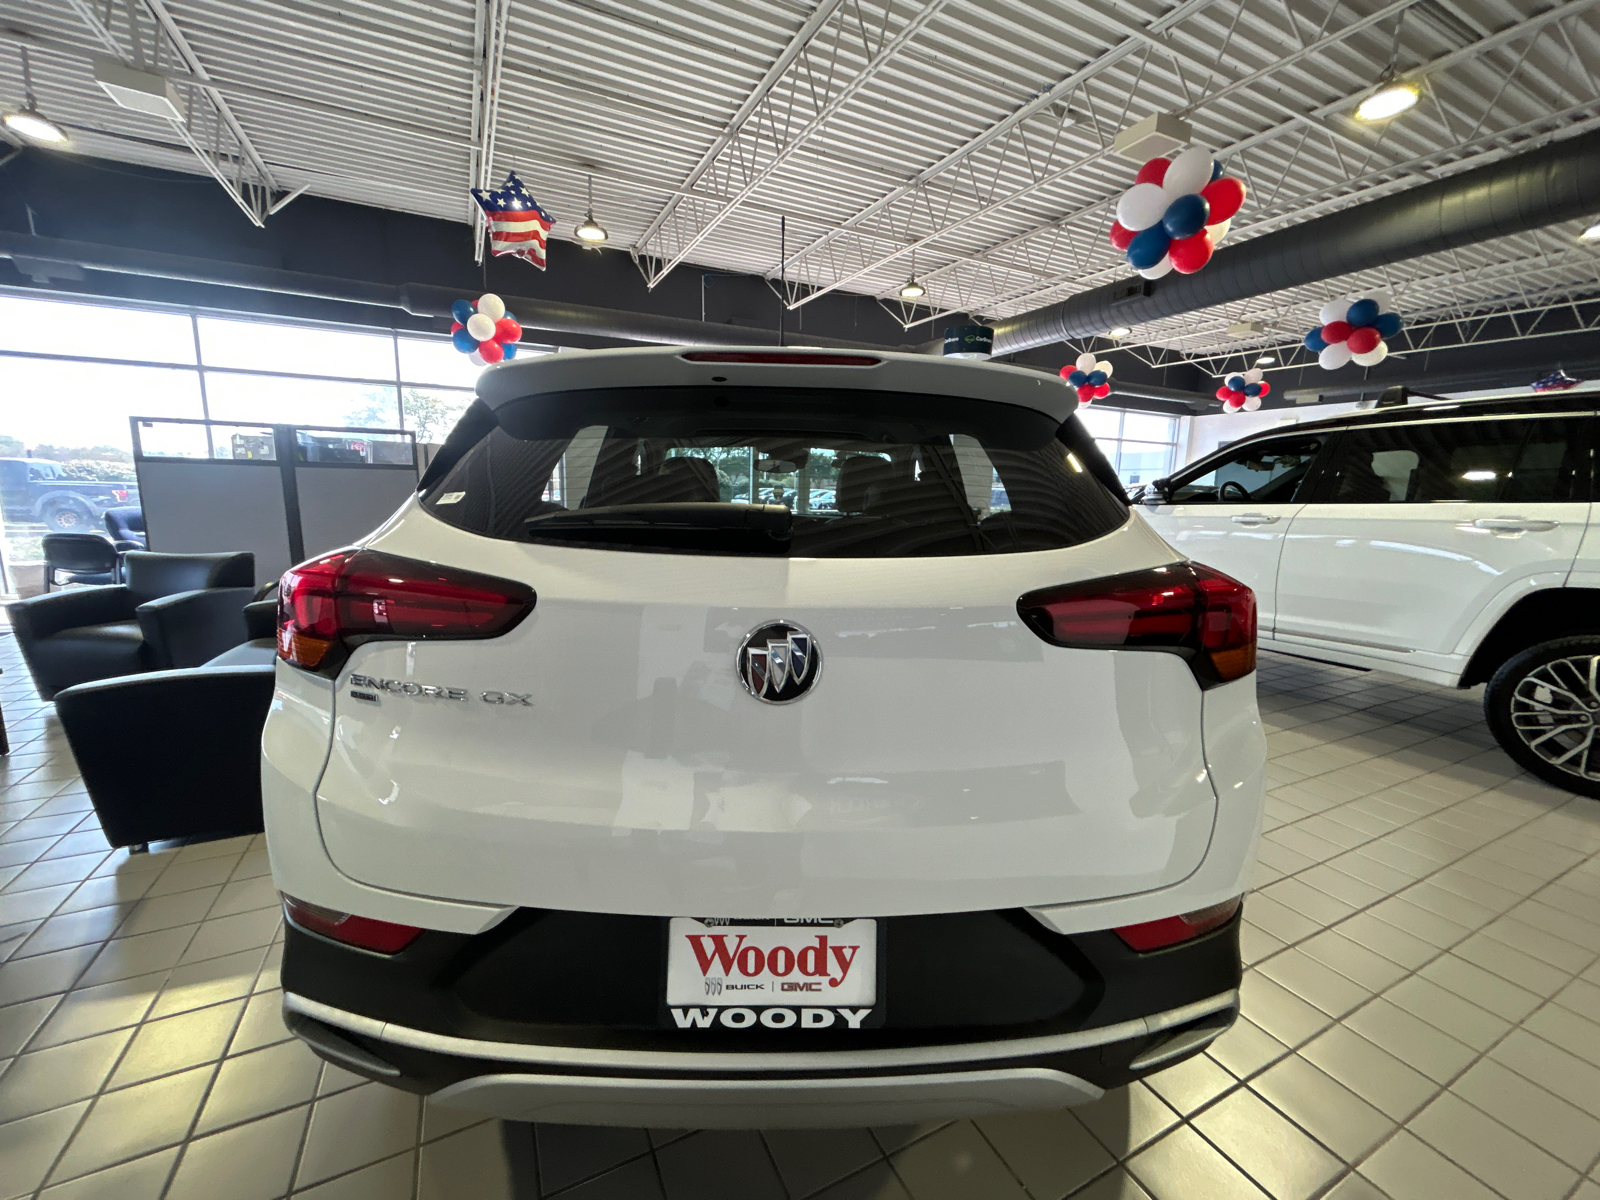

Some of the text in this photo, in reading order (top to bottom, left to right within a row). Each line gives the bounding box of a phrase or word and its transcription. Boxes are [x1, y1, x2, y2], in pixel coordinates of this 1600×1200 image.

[350, 673, 468, 702] ENCORE
[479, 690, 534, 707] GX
[685, 934, 861, 988] Woody
[780, 982, 822, 992] GMC
[670, 1007, 873, 1029] WOODY
